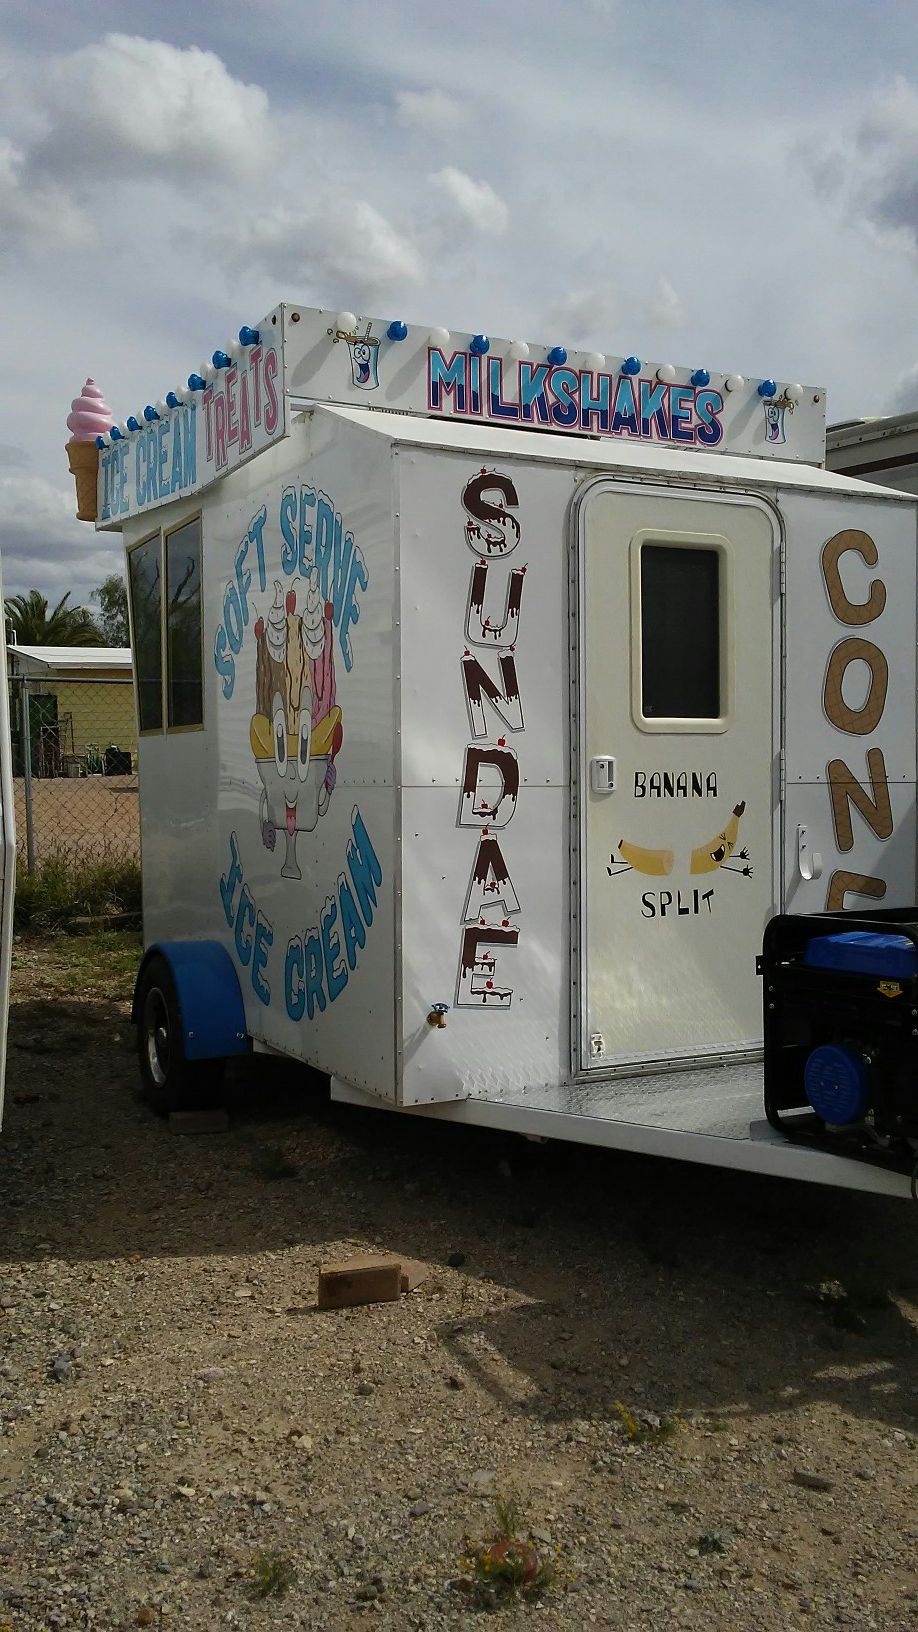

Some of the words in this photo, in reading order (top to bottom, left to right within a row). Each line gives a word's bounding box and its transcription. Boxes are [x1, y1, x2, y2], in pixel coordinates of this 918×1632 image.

[202, 344, 278, 472] TREATS
[427, 346, 724, 447] MILKSHAKES
[101, 447, 128, 521] ICE
[135, 402, 197, 508] CREAM
[214, 504, 267, 699] SOFT
[279, 483, 369, 673] SERVE
[455, 467, 528, 1009] SUNDAE
[634, 771, 718, 798] BANANA
[219, 831, 273, 1006] ICE
[284, 804, 383, 1022] CREAM
[640, 888, 715, 918] SPLIT
